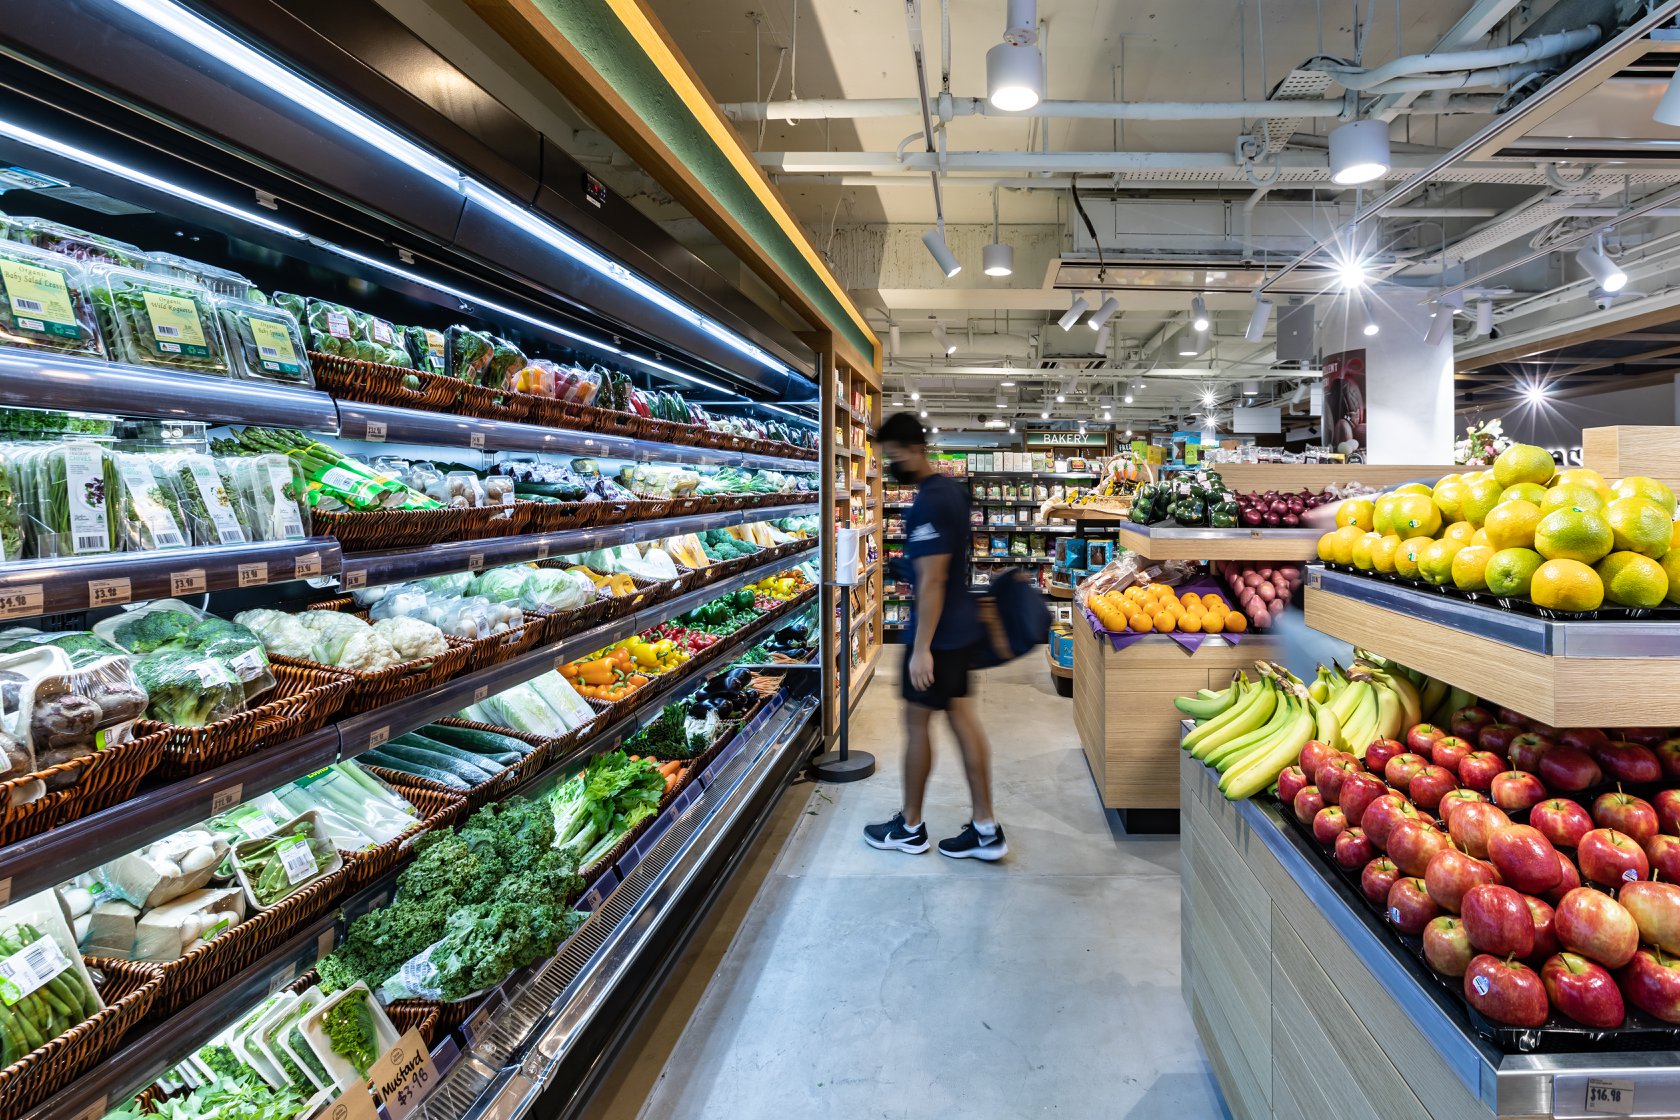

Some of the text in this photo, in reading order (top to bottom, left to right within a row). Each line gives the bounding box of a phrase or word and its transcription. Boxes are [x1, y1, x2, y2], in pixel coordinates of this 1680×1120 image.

[18, 265, 47, 277] Organic
[4, 270, 66, 291] Baby Salad Leaves
[151, 302, 167, 310] Wild
[159, 296, 182, 305] Organic
[257, 327, 269, 336] Baby
[1043, 433, 1089, 445] BAKERY
[242, 570, 258, 580] $3.98
[175, 577, 194, 590] $3.98
[94, 587, 118, 600] $3.98
[0, 595, 27, 609] $4.98
[381, 1049, 424, 1103] Mustard
[397, 1067, 429, 1106] $3.98
[1590, 1088, 1622, 1102] $16.98
